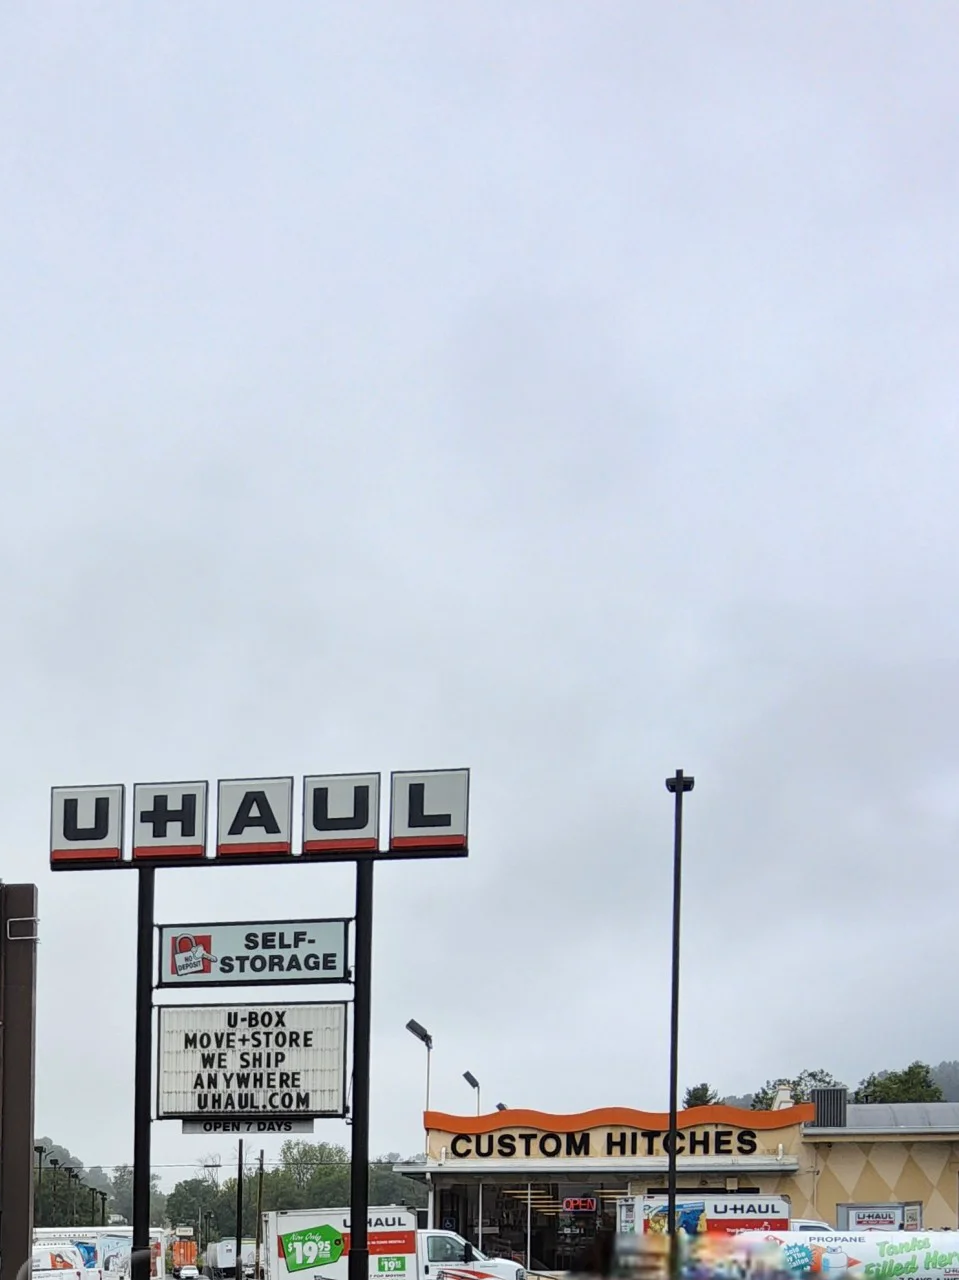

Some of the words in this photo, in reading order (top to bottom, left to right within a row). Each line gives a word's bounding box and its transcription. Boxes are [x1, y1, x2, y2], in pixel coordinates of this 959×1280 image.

[245, 931, 315, 950] SELF-
[178, 961, 202, 971] DEPOSIT
[219, 953, 337, 973] STORAGE
[227, 1011, 286, 1028] U-BOX
[184, 1031, 313, 1049] MOVE+STORE
[201, 1053, 227, 1069] WE
[240, 1052, 286, 1068] SHIP
[193, 1072, 301, 1089] ANYWHERE
[197, 1092, 310, 1109] UHAUL.COM
[203, 1122, 240, 1132] OPEN
[245, 1122, 252, 1131] 7
[257, 1121, 292, 1131] DAYS
[451, 1132, 590, 1157] CUSTOM
[607, 1130, 757, 1156] HITCHES
[565, 1199, 594, 1210] OPEN
[305, 1233, 321, 1241] Only
[876, 1237, 931, 1257] Tanks
[865, 1255, 919, 1278] Filled
[924, 1251, 959, 1270] Her
